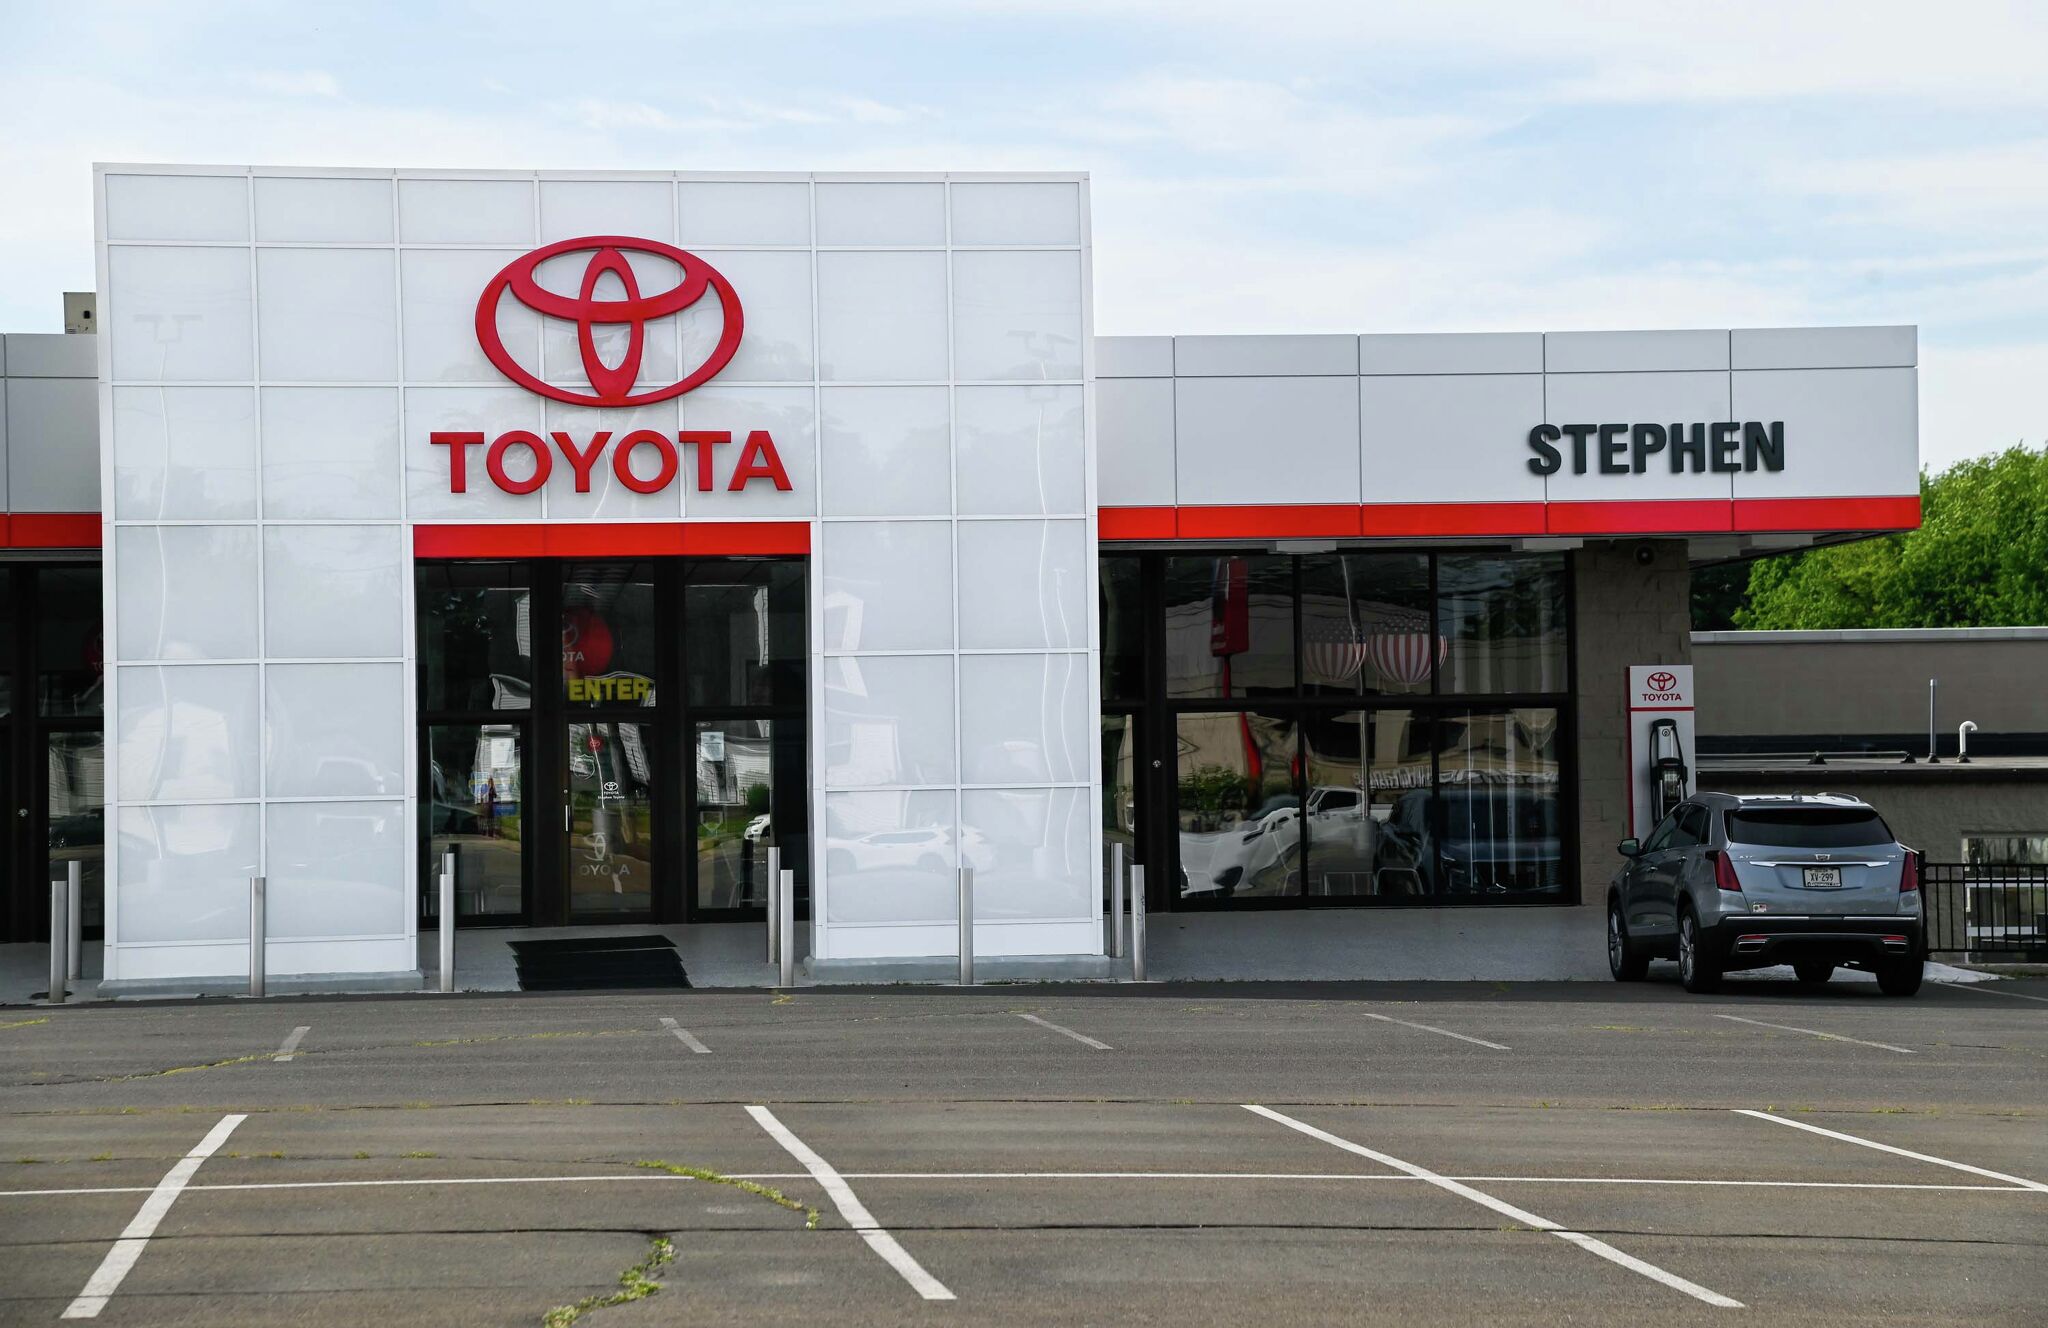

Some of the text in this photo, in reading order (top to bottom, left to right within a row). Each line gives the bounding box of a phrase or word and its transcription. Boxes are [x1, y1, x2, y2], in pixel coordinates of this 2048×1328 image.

[430, 430, 793, 494] TOYOTA
[1528, 421, 1784, 475] STEPHEN
[569, 678, 648, 701] ENTER
[1642, 693, 1682, 702] TOYOTA
